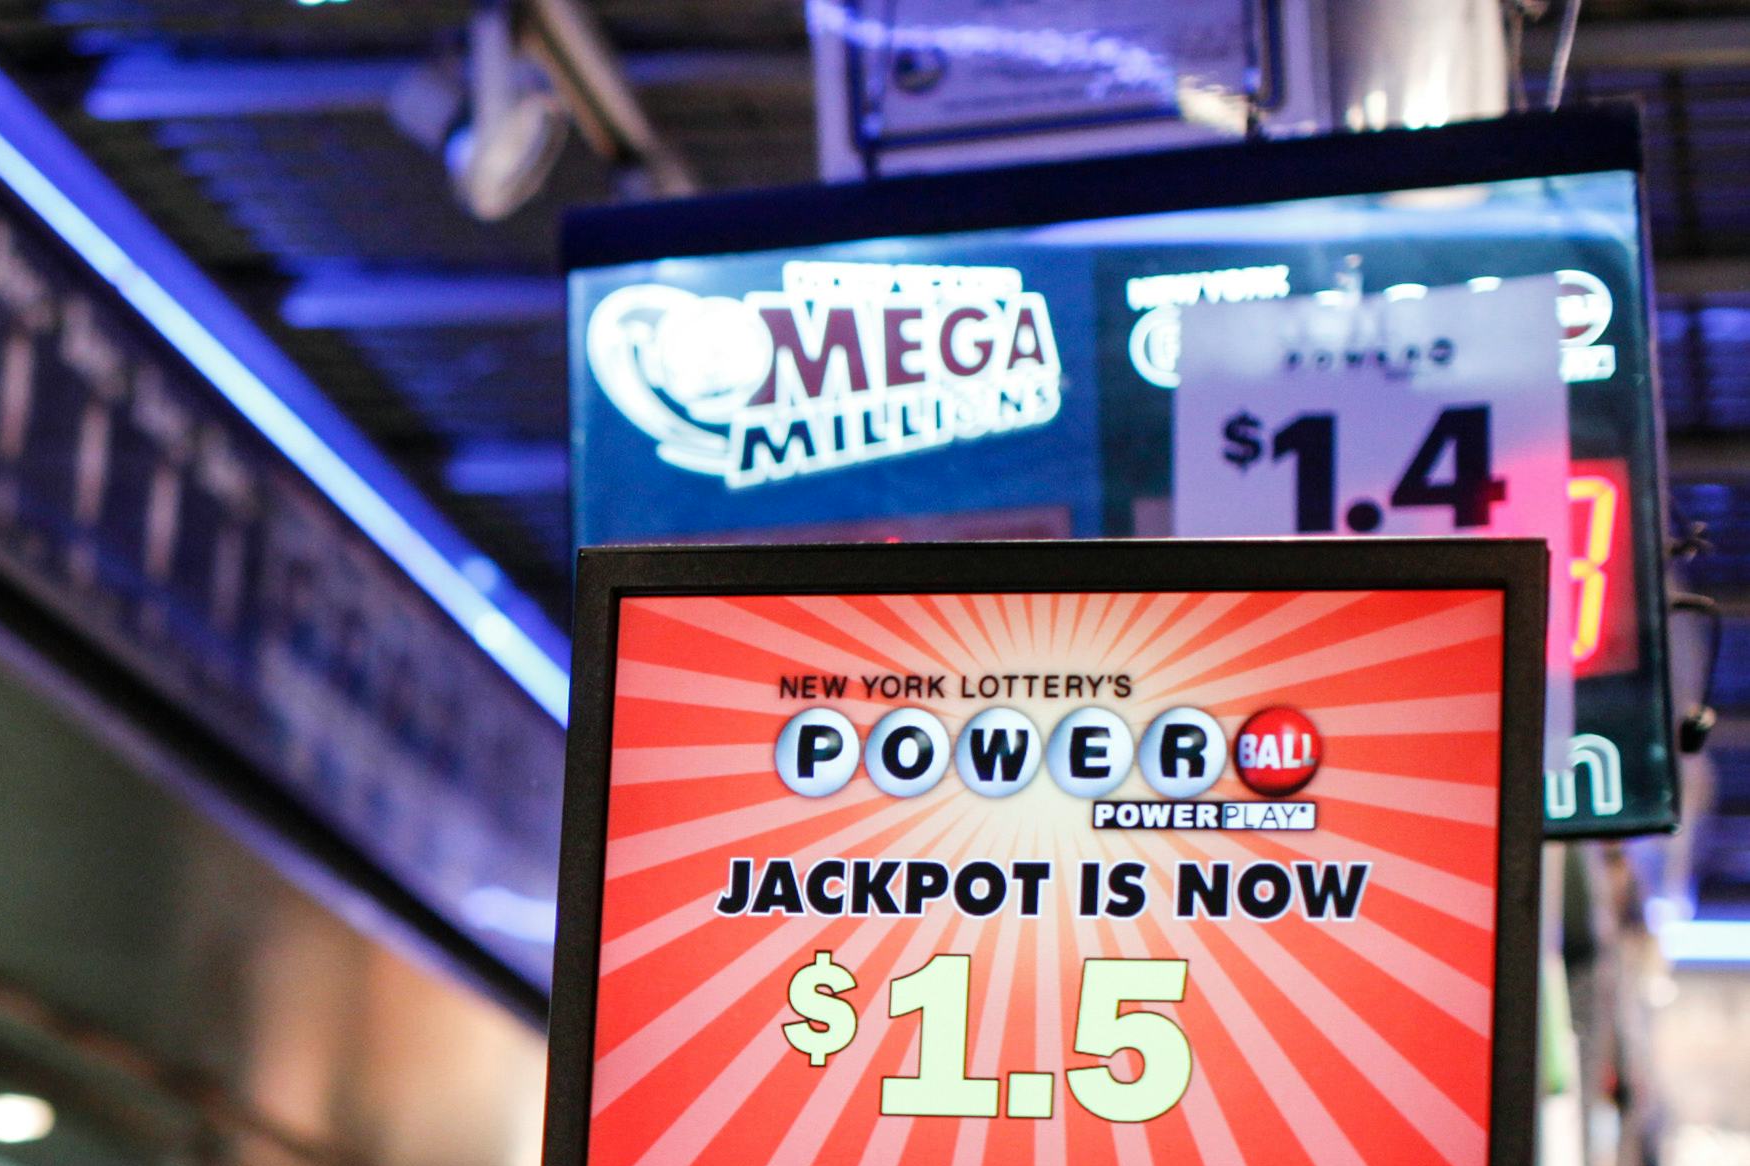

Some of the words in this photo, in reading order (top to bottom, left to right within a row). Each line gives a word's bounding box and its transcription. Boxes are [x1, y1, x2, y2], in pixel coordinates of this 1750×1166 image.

[748, 306, 1046, 409] MEGA
[779, 676, 848, 699] NEW
[861, 675, 945, 699] YORK
[961, 674, 1133, 700] LOTTERY'S
[716, 857, 1051, 918] JACKPOT
[1077, 859, 1148, 919] IS
[1174, 859, 1373, 922] NOW
[781, 949, 1193, 1124] $1.5
